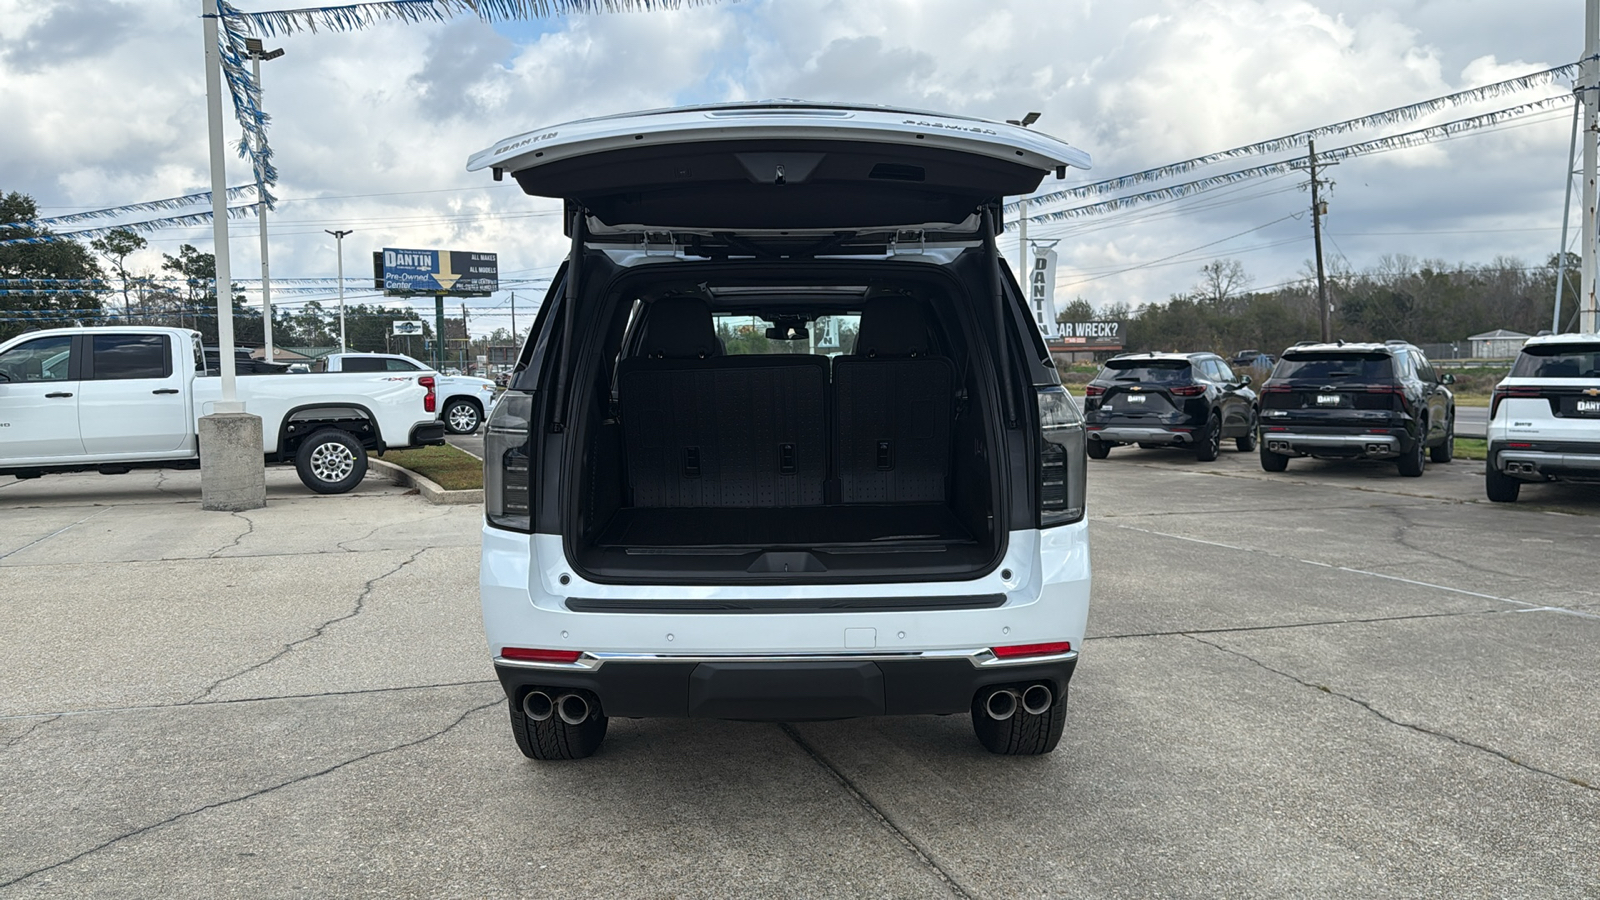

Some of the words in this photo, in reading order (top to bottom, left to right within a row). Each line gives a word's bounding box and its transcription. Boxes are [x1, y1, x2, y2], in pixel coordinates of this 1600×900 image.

[494, 132, 558, 156] DANTIN
[384, 250, 432, 267] DANTIN
[478, 266, 497, 274] MODELS
[385, 272, 429, 281] Pre-Owned
[385, 281, 412, 289] Center
[1075, 322, 1119, 337] WRECK?
